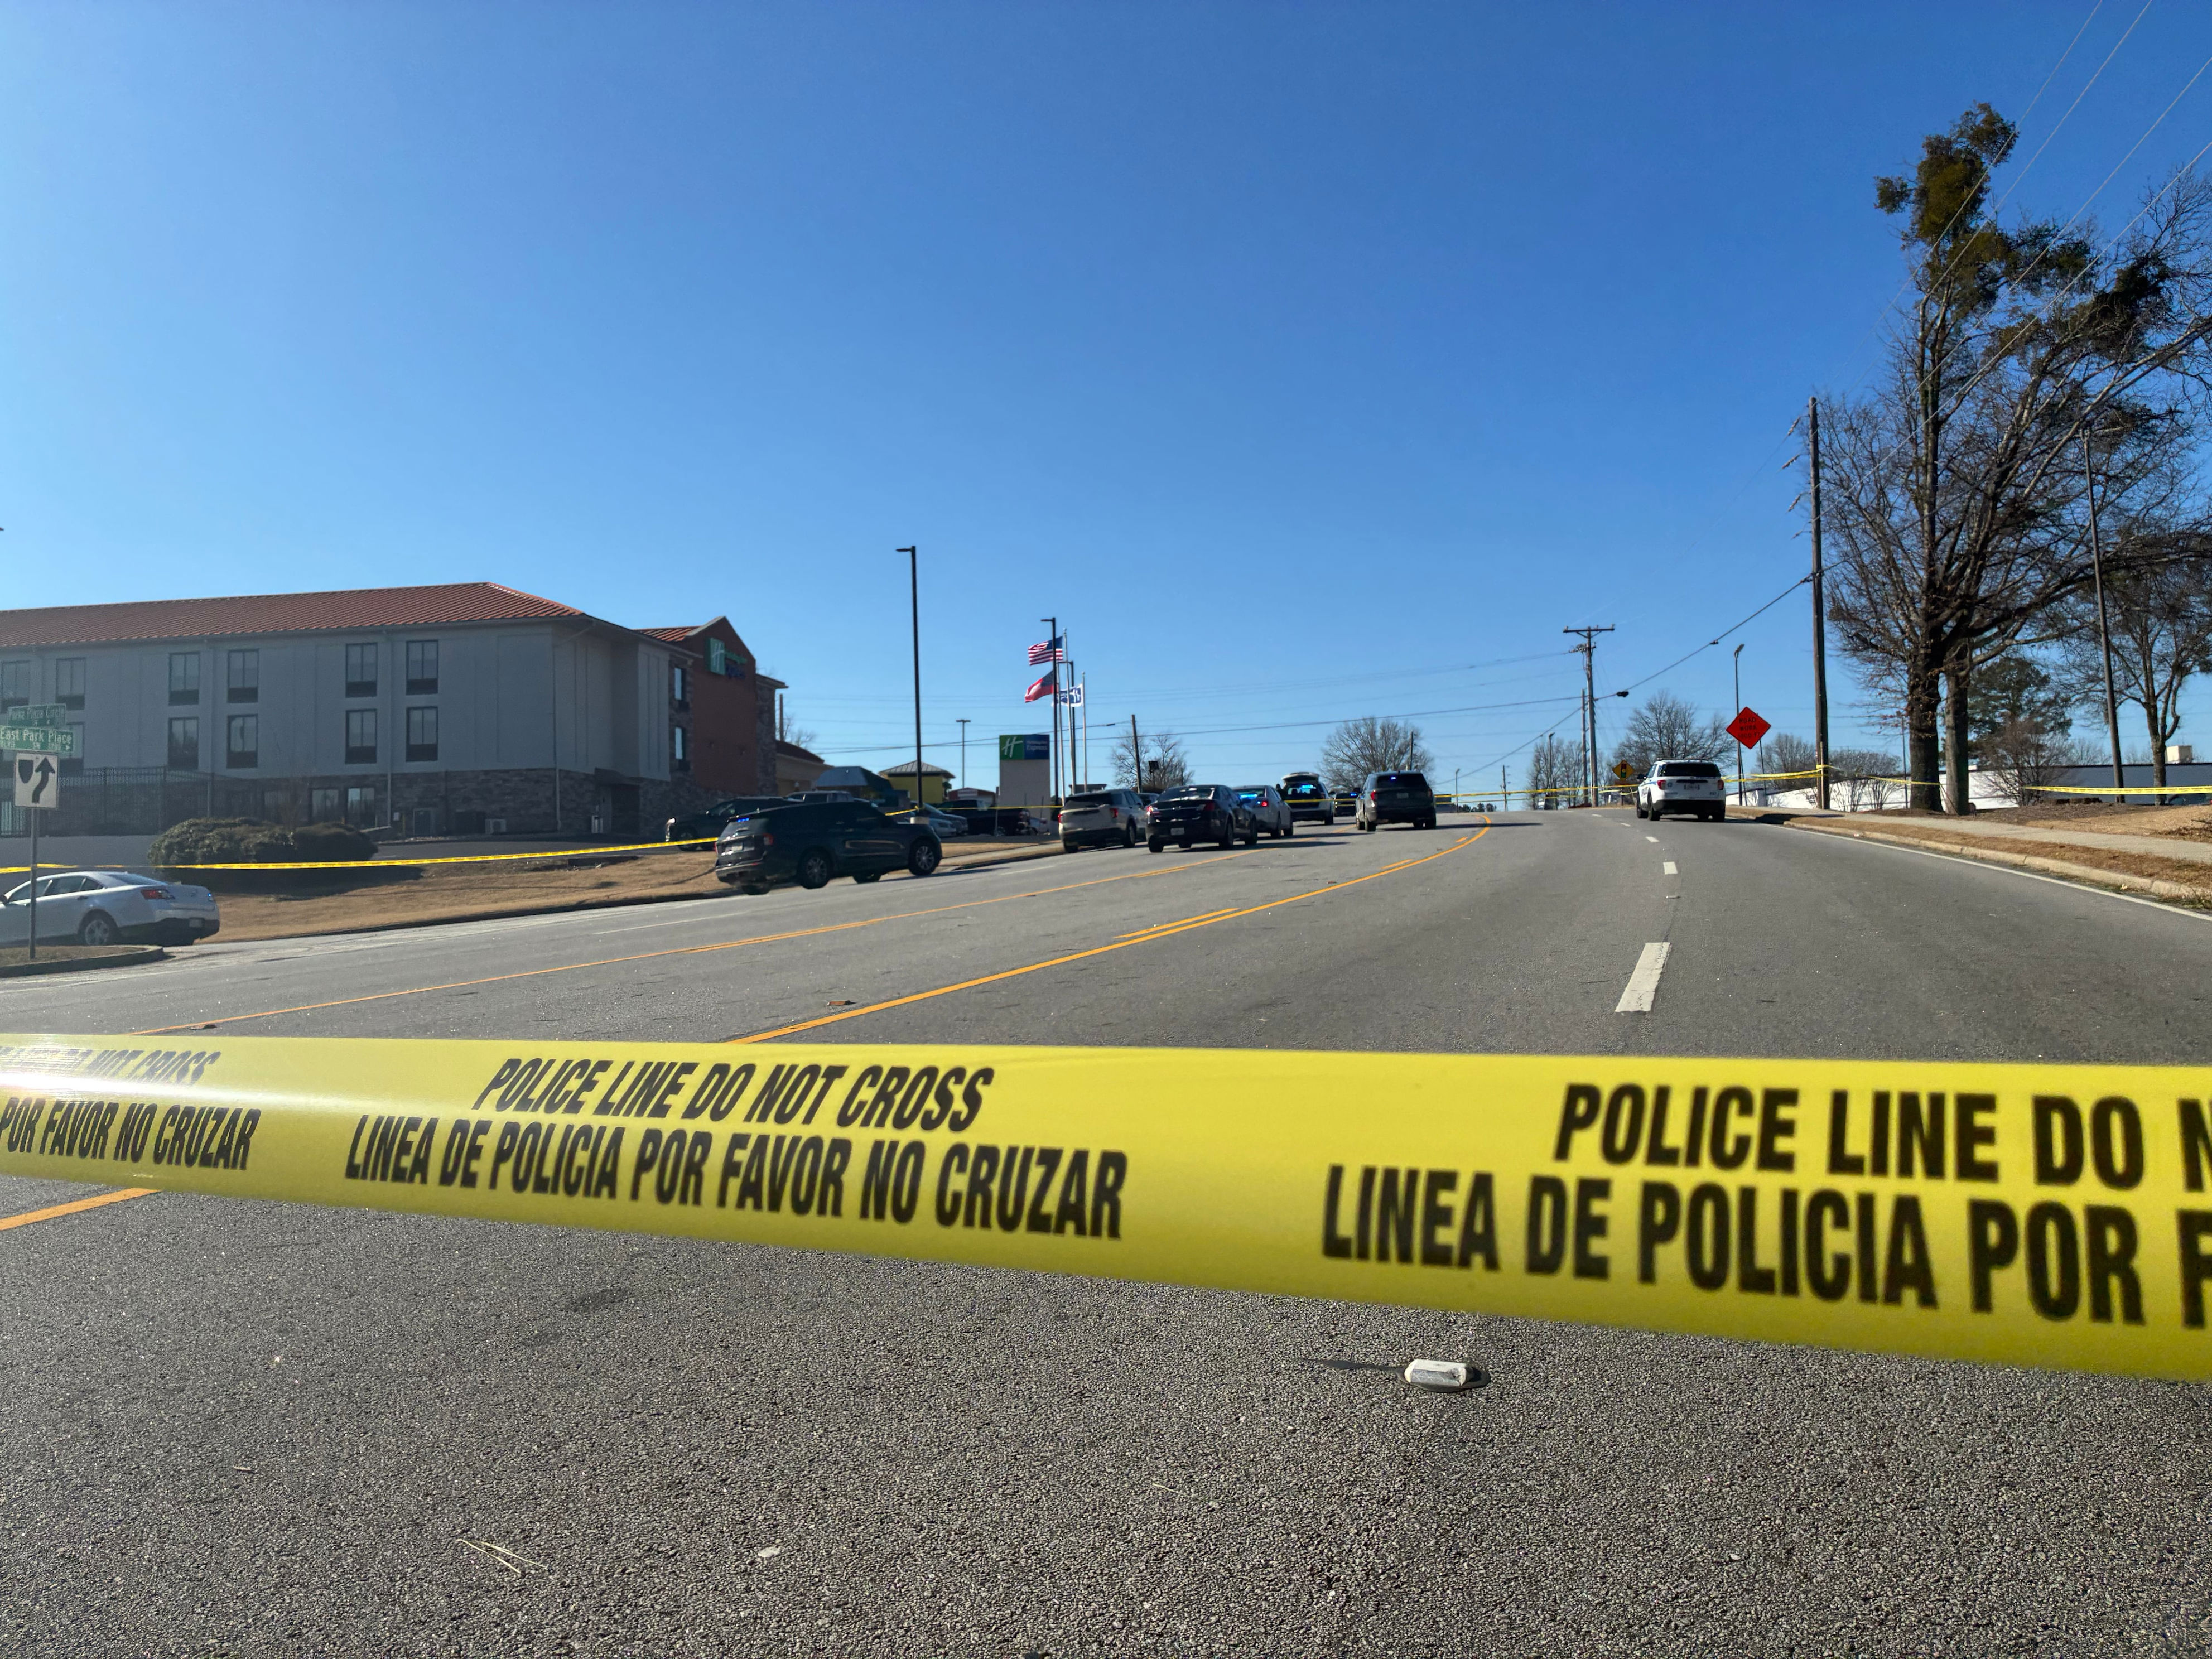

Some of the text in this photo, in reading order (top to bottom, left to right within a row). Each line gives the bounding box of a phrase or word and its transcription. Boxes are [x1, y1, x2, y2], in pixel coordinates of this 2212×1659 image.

[0, 728, 71, 744] East Park Place
[0, 1097, 261, 1170] POR FAVOR NO CRUZAR
[471, 1058, 995, 1132] POLICE LINE DO NOT CROSS
[1553, 1083, 1800, 1173] POLICE
[1827, 1089, 1999, 1184] LINE
[2031, 1094, 2144, 1191] DO
[344, 1114, 1129, 1242] LINEA DE POLICIA POR FAVOR NO CRUZAR
[1321, 1164, 1502, 1274] LINEA
[1524, 1174, 1612, 1283] DE
[1637, 1180, 1940, 1312] POLICIA
[1967, 1197, 2148, 1329] POR
